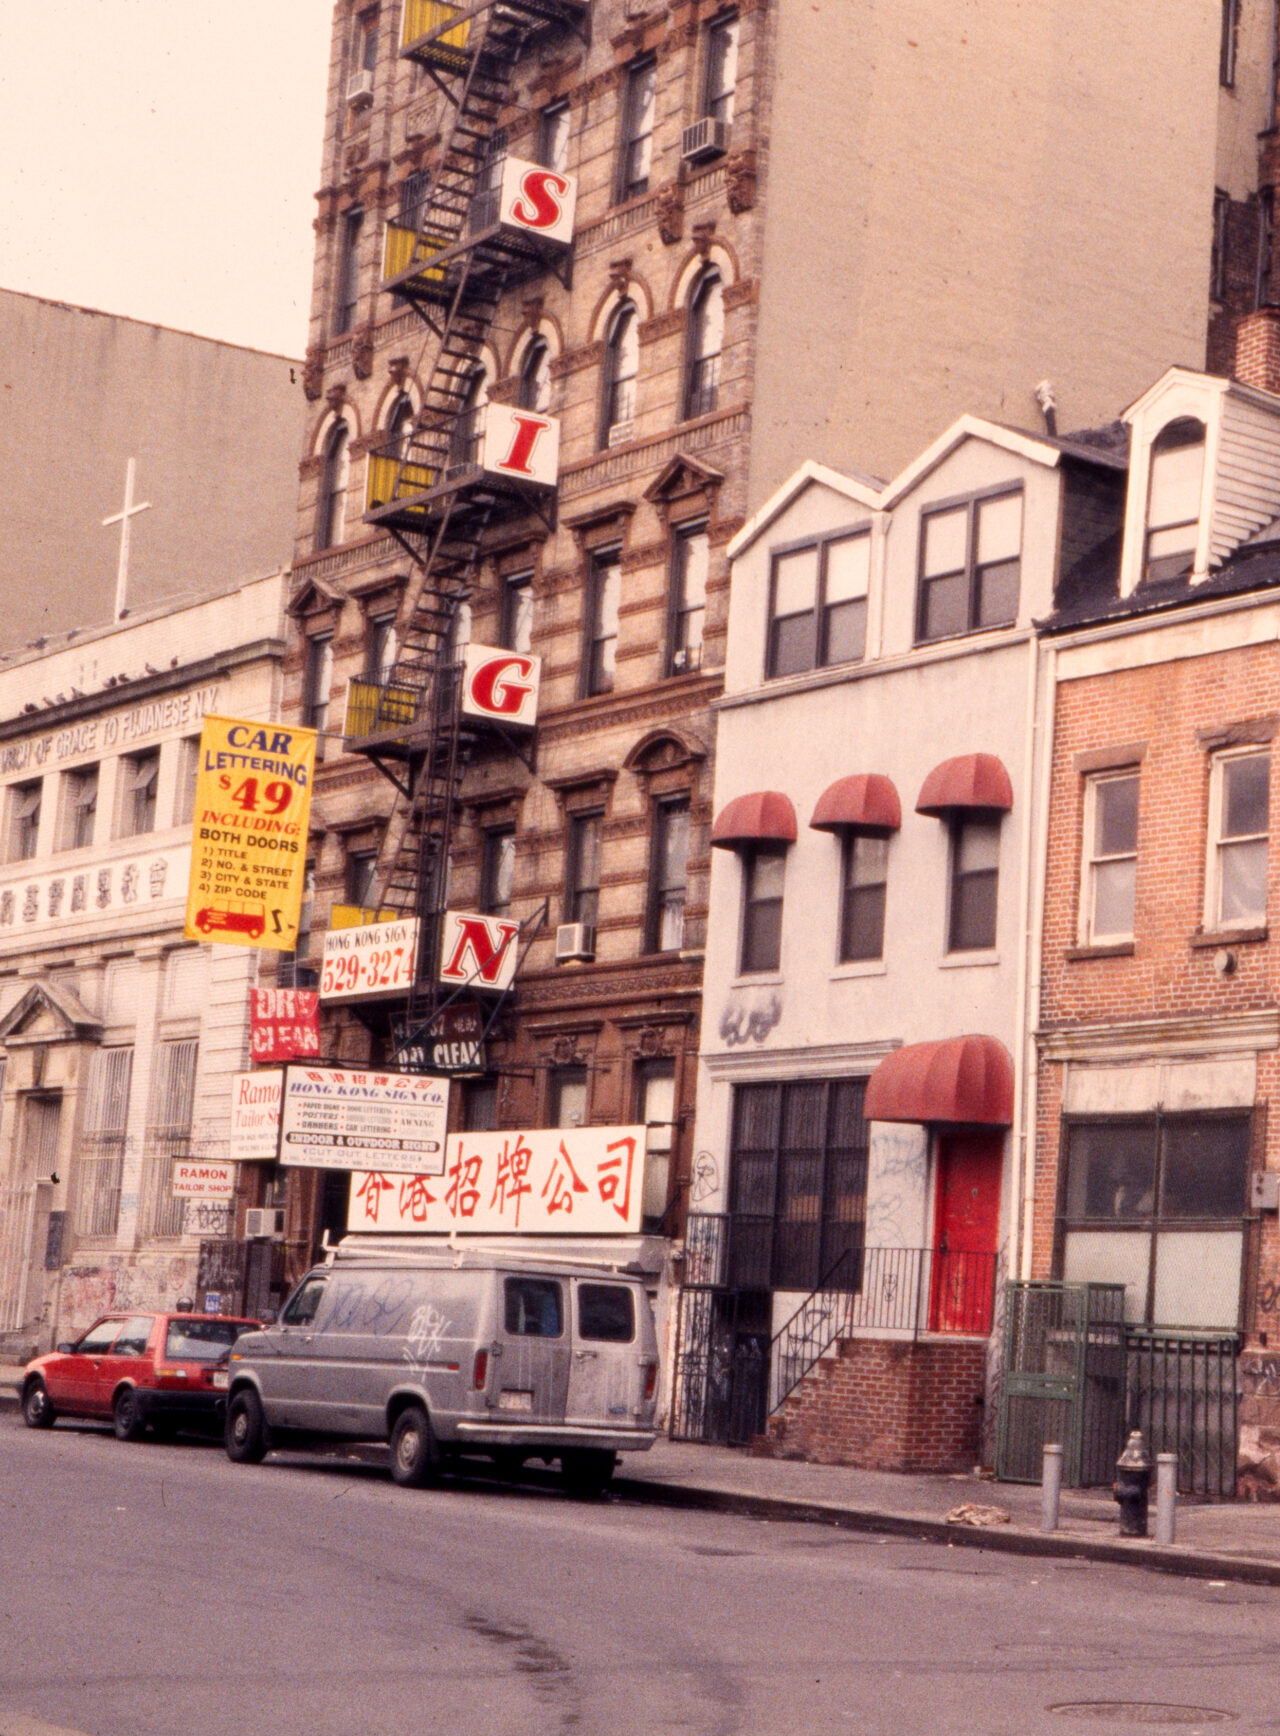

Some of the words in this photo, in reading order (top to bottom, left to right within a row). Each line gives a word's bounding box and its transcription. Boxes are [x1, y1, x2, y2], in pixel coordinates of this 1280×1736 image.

[513, 172, 567, 228] S
[471, 657, 534, 715] G
[35, 736, 52, 765] OF
[57, 723, 97, 759] GRACE
[103, 717, 119, 745] TO
[123, 696, 191, 737] FUJIANESE
[228, 726, 292, 755] CAR
[205, 750, 307, 787] LETTERING
[219, 774, 293, 815] $49
[201, 810, 301, 836] INCLUDING:
[200, 828, 241, 844] BOTH
[247, 835, 299, 853] DOORS
[218, 848, 248, 859] TITLE
[200, 871, 212, 881] 3)
[215, 873, 239, 883] CITY
[243, 876, 251, 885] &
[255, 878, 289, 889] STATE
[201, 858, 212, 868] 2)
[216, 861, 236, 871] NO.
[241, 864, 248, 872] &
[252, 865, 294, 877] STREET
[199, 883, 210, 893] 4)
[214, 884, 232, 894] ZIP
[235, 888, 267, 900] CODE
[326, 934, 350, 951] HONG
[355, 929, 381, 948] KONG
[385, 925, 407, 944] SIGN
[443, 919, 519, 981] N
[257, 988, 310, 1018] DRY
[254, 1026, 318, 1052] CLEAN
[434, 1041, 481, 1068] CLEAN
[239, 1078, 280, 1105] Ramo
[290, 1083, 333, 1094] HONG
[337, 1087, 379, 1097] KONG
[385, 1090, 417, 1101] SIGN
[422, 1093, 444, 1104] CO.
[235, 1110, 265, 1128] Tailor
[302, 1111, 339, 1120] POSTERS
[401, 1119, 435, 1128] AWNING
[289, 1133, 335, 1146] INDOOR
[337, 1136, 345, 1145] &
[347, 1137, 401, 1150] OUTDOOR
[402, 1141, 437, 1152] SIGNS
[307, 1147, 331, 1156] CUT
[337, 1149, 361, 1158] OUT
[366, 1151, 416, 1162] LETTERS
[180, 1168, 227, 1179] RAMON
[174, 1183, 205, 1192] TAILOR
